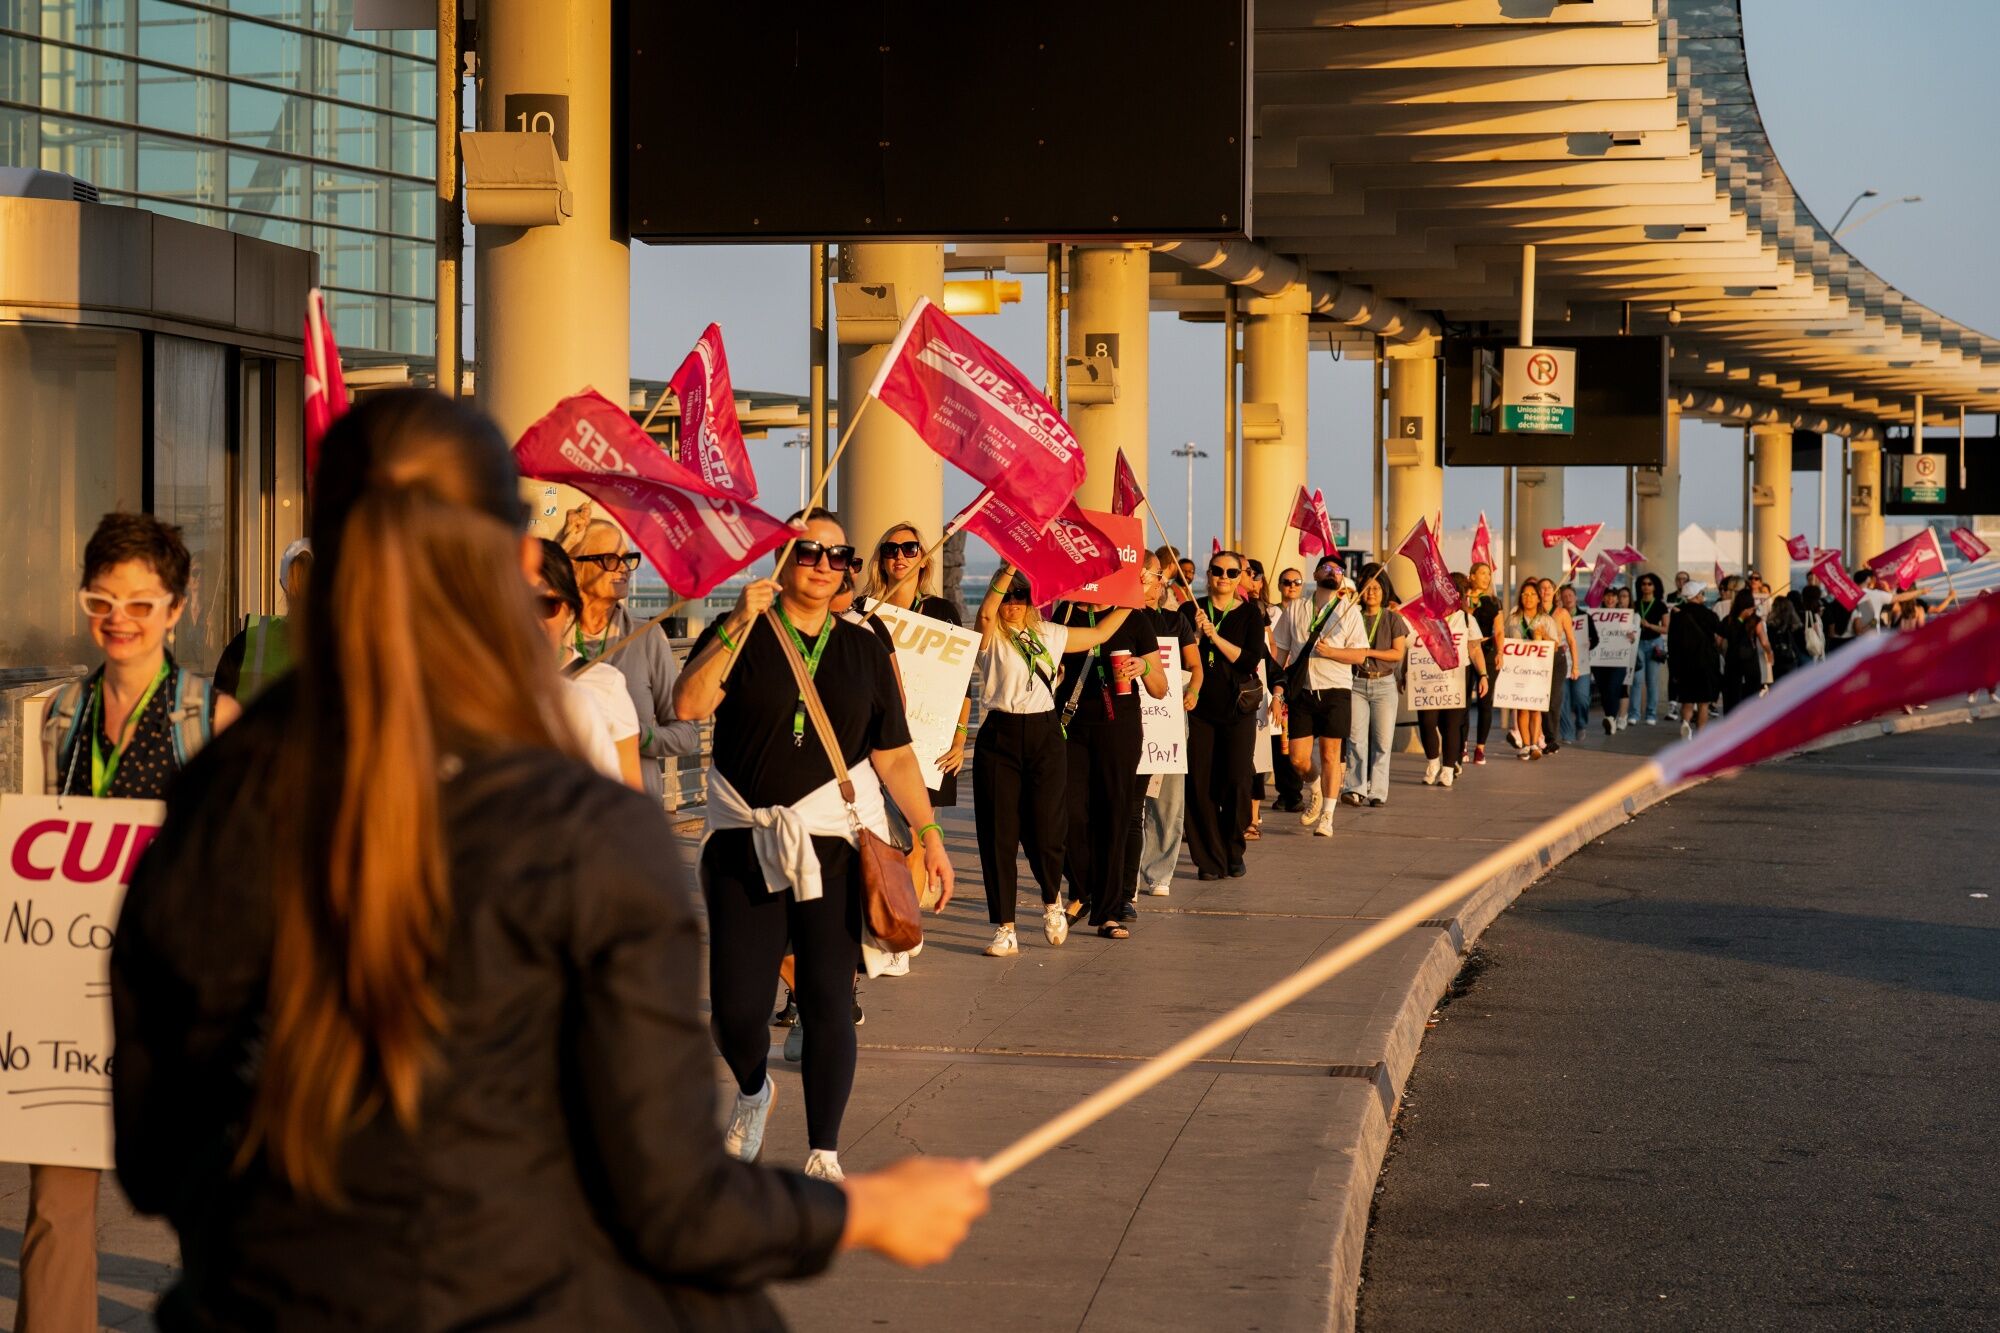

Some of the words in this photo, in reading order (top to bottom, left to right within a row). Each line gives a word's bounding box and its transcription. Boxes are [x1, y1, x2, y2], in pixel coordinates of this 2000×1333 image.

[517, 111, 555, 135] 10
[1095, 342, 1108, 358] 8
[943, 395, 978, 421] FIGHTING
[950, 351, 1014, 400] CUPE
[1021, 402, 1079, 450] SCFP
[938, 404, 954, 417] FOR
[1517, 406, 1551, 415] Unloading
[1551, 407, 1565, 415] Only
[1406, 422, 1416, 435] 6
[987, 424, 1017, 451] LUTTER
[1028, 424, 1067, 459] Ontario
[704, 432, 734, 490] SCFP
[1020, 520, 1042, 542] LUTTER
[1054, 529, 1081, 561] Ontario
[1572, 618, 1584, 631] E
[1591, 611, 1631, 623] CUPE
[1414, 632, 1464, 648] CE
[1502, 643, 1550, 658] CUPE
[1414, 692, 1461, 707] EXCUSES
